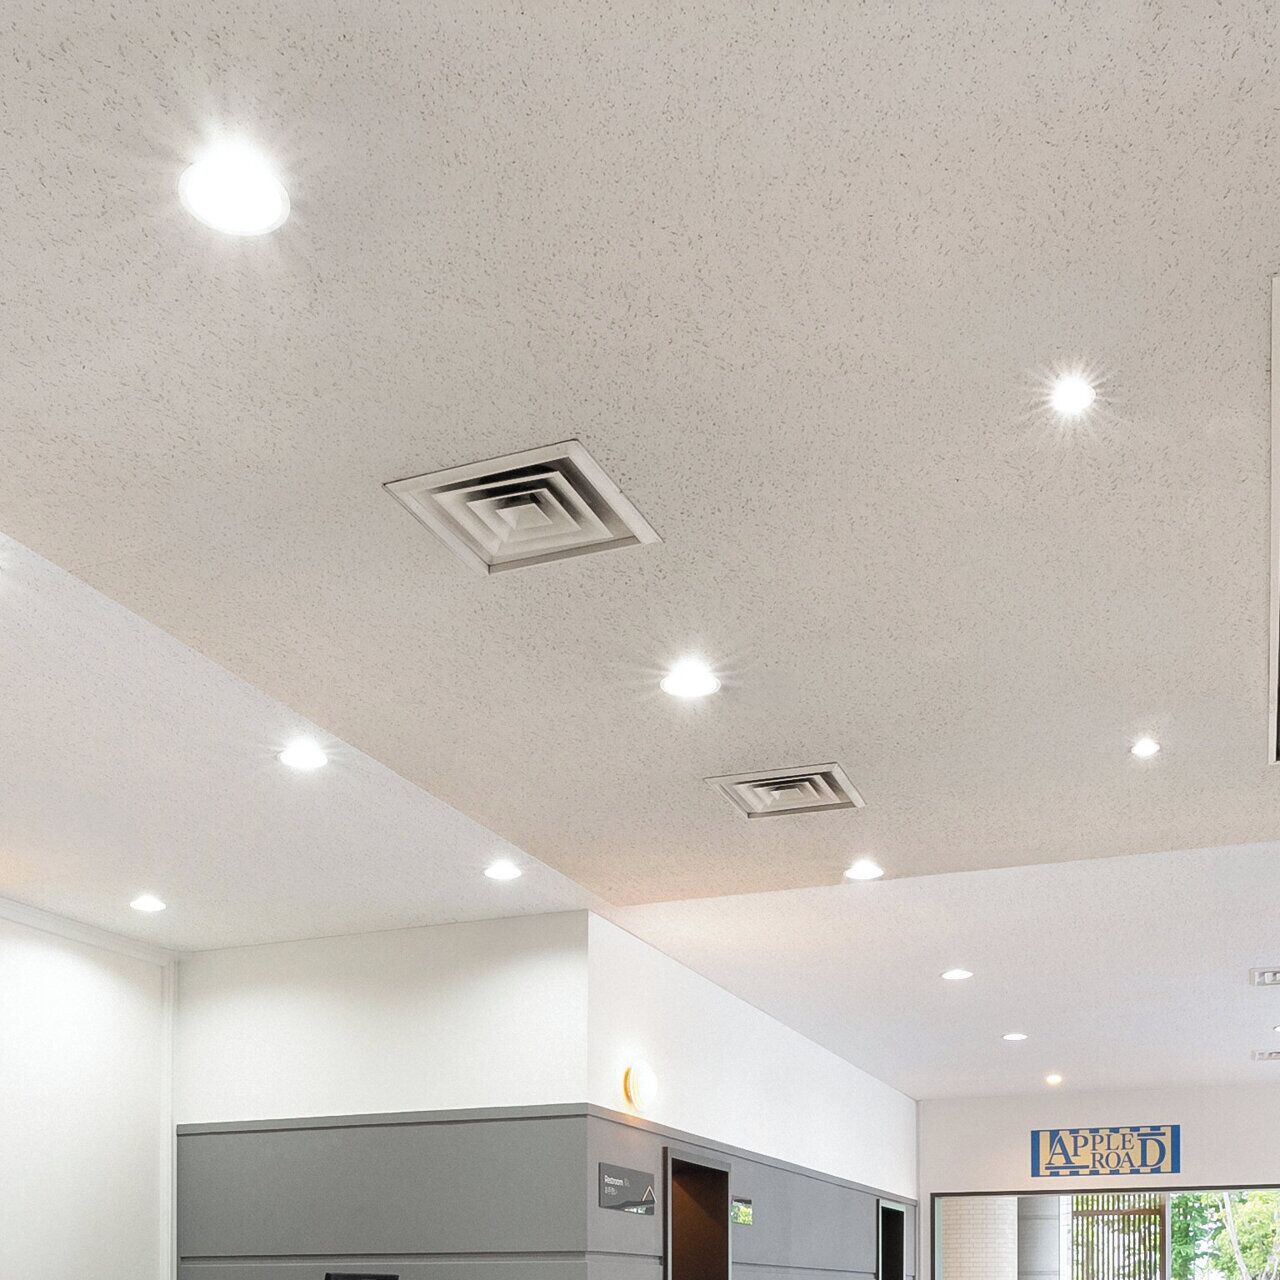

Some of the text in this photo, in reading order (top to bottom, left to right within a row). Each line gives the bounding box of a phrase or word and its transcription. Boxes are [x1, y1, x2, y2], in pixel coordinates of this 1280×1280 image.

[1046, 1133, 1134, 1165] APPLE
[1090, 1137, 1166, 1168] ROAD
[604, 1175, 624, 1186] Restroom
